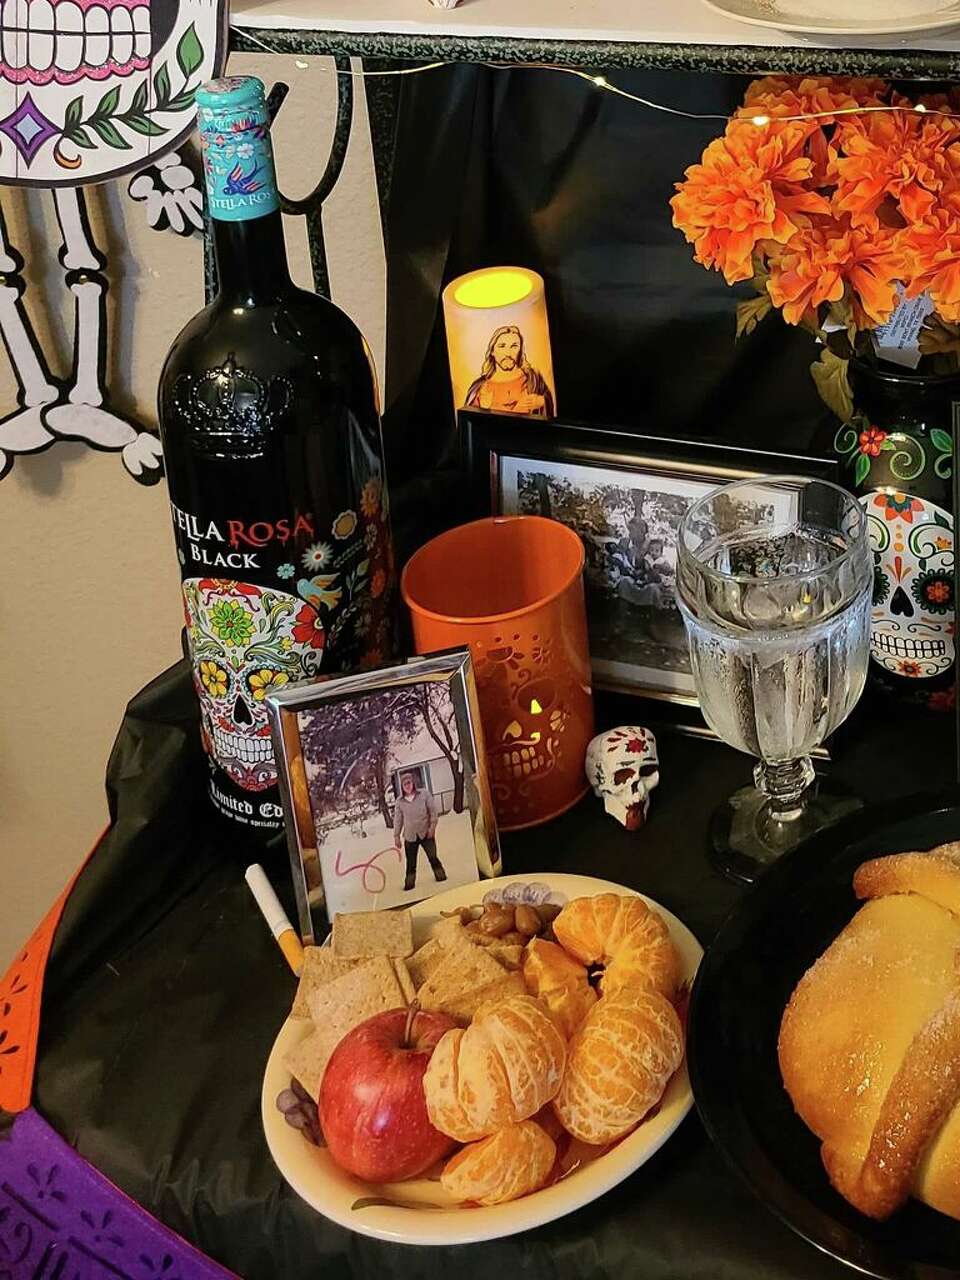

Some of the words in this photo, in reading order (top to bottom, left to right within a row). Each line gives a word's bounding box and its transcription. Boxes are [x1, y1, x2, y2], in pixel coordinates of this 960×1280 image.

[170, 501, 225, 542] TELLA
[227, 512, 315, 549] ROSA
[190, 543, 261, 569] BLACK
[210, 778, 253, 815] Limited
